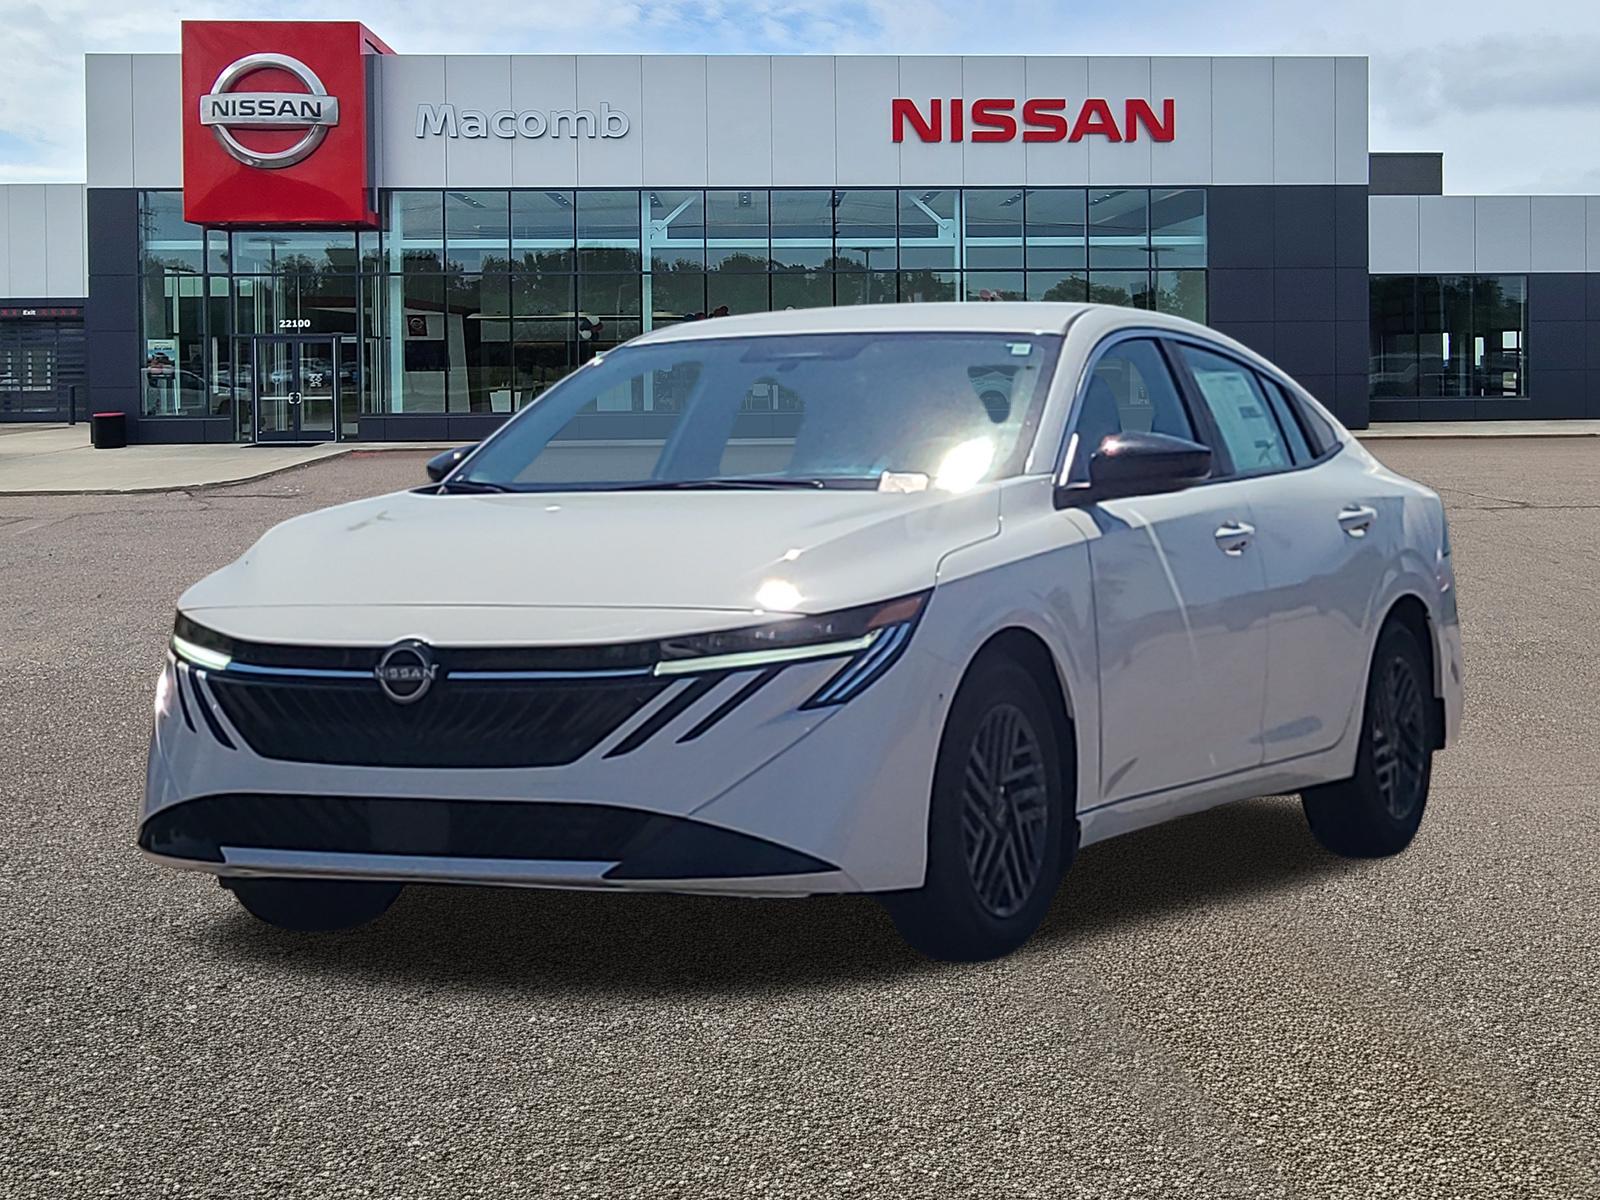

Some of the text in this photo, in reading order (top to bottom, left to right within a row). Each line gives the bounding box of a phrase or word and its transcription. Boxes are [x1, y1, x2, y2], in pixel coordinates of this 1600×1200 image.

[212, 100, 321, 117] NISSAN
[415, 101, 630, 139] Macomb
[892, 98, 1175, 143] NISSAN
[279, 319, 311, 328] 22100
[374, 667, 434, 679] NISSAN
